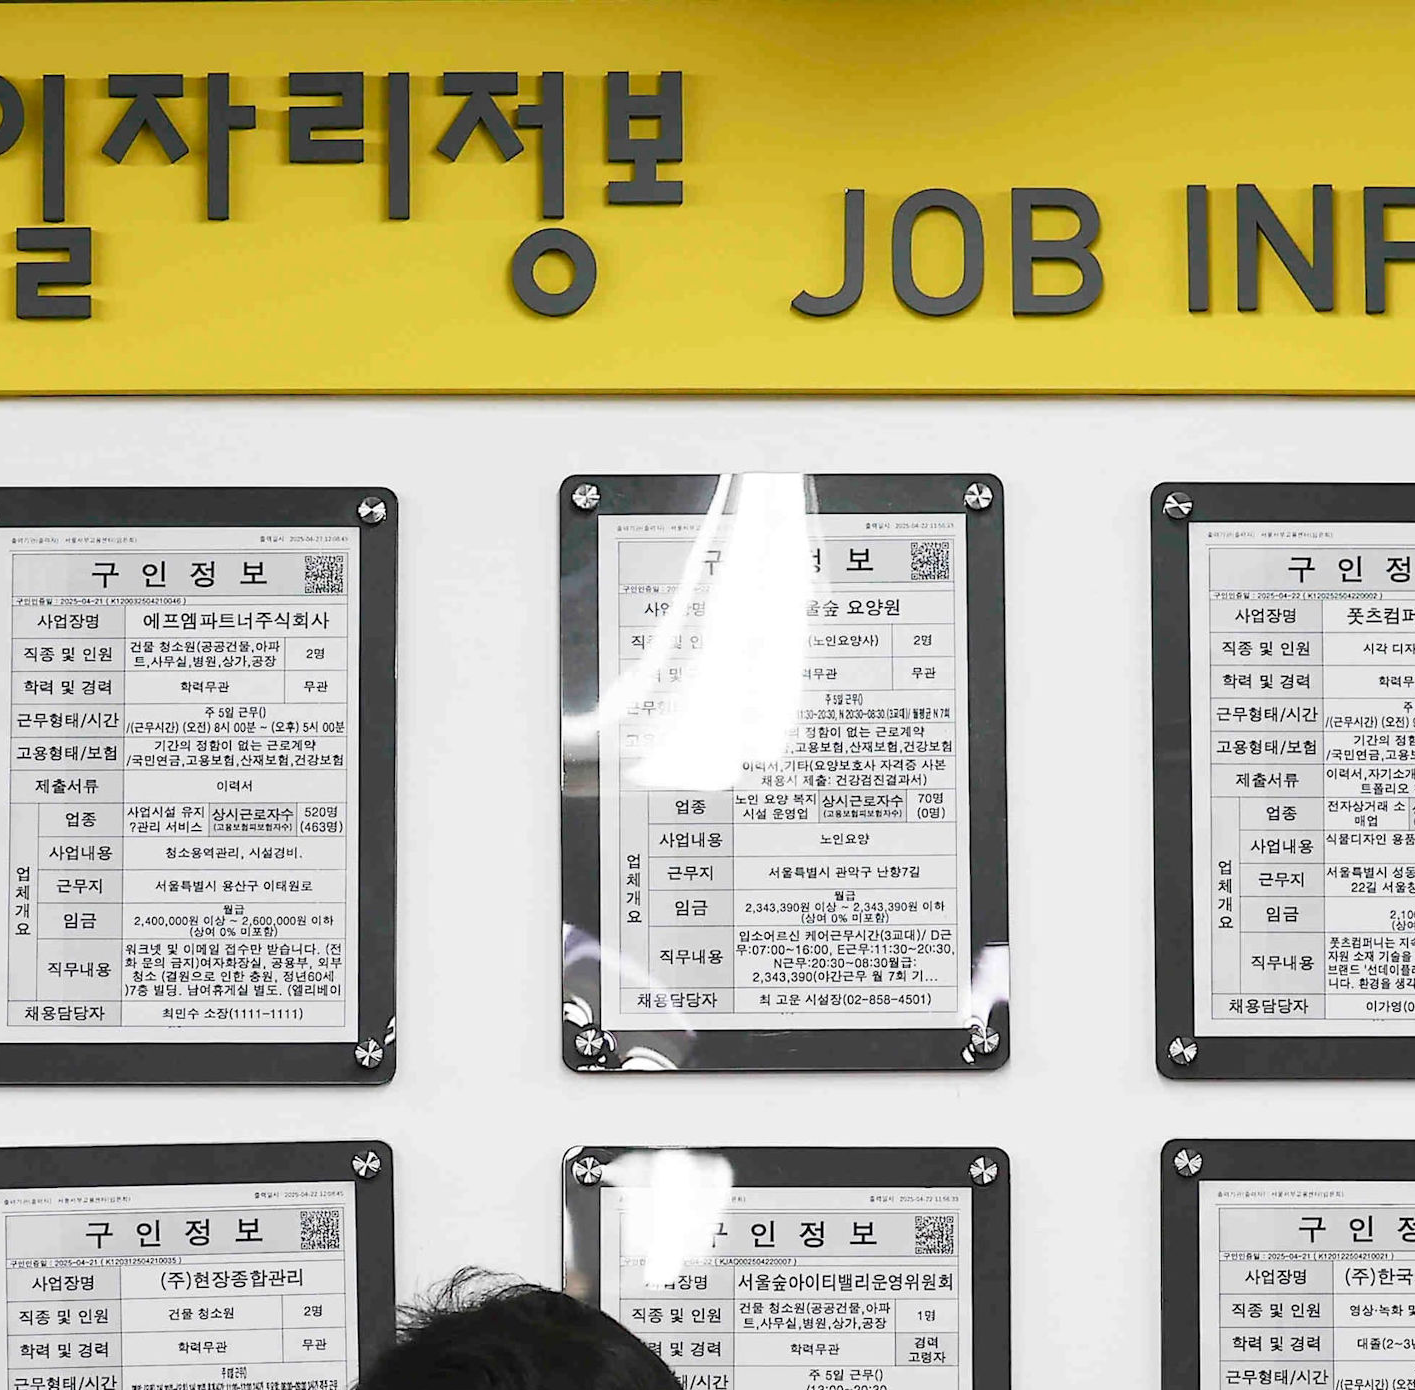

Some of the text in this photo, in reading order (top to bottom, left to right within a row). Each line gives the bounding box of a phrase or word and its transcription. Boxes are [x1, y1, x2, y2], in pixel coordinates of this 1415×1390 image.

[791, 187, 1104, 317] JOB
[846, 598, 900, 617] 요양원
[143, 611, 330, 631] 에프엠파트너주식회사
[306, 647, 325, 660] 2명
[1363, 642, 1388, 655] 시각
[1222, 673, 1310, 690] 학력 경력
[16, 745, 117, 762] 고용형태/보험
[1235, 772, 1300, 789] 제출서류
[675, 799, 707, 815] 업종
[822, 794, 904, 809] 상시근로자수
[304, 805, 338, 819] 520명
[659, 831, 723, 849] 사업내용
[819, 832, 870, 846] 노인요양
[835, 866, 873, 879] 관악구
[1258, 871, 1305, 888] 근무지
[221, 879, 313, 893] 용산구 이태원로
[674, 899, 709, 917] 임금
[47, 961, 112, 978] 직무내용
[204, 1007, 304, 1021] 소장(1111-1111)
[160, 1268, 303, 1291] (주)현장종합관리
[168, 1306, 234, 1321] 건물 청소원
